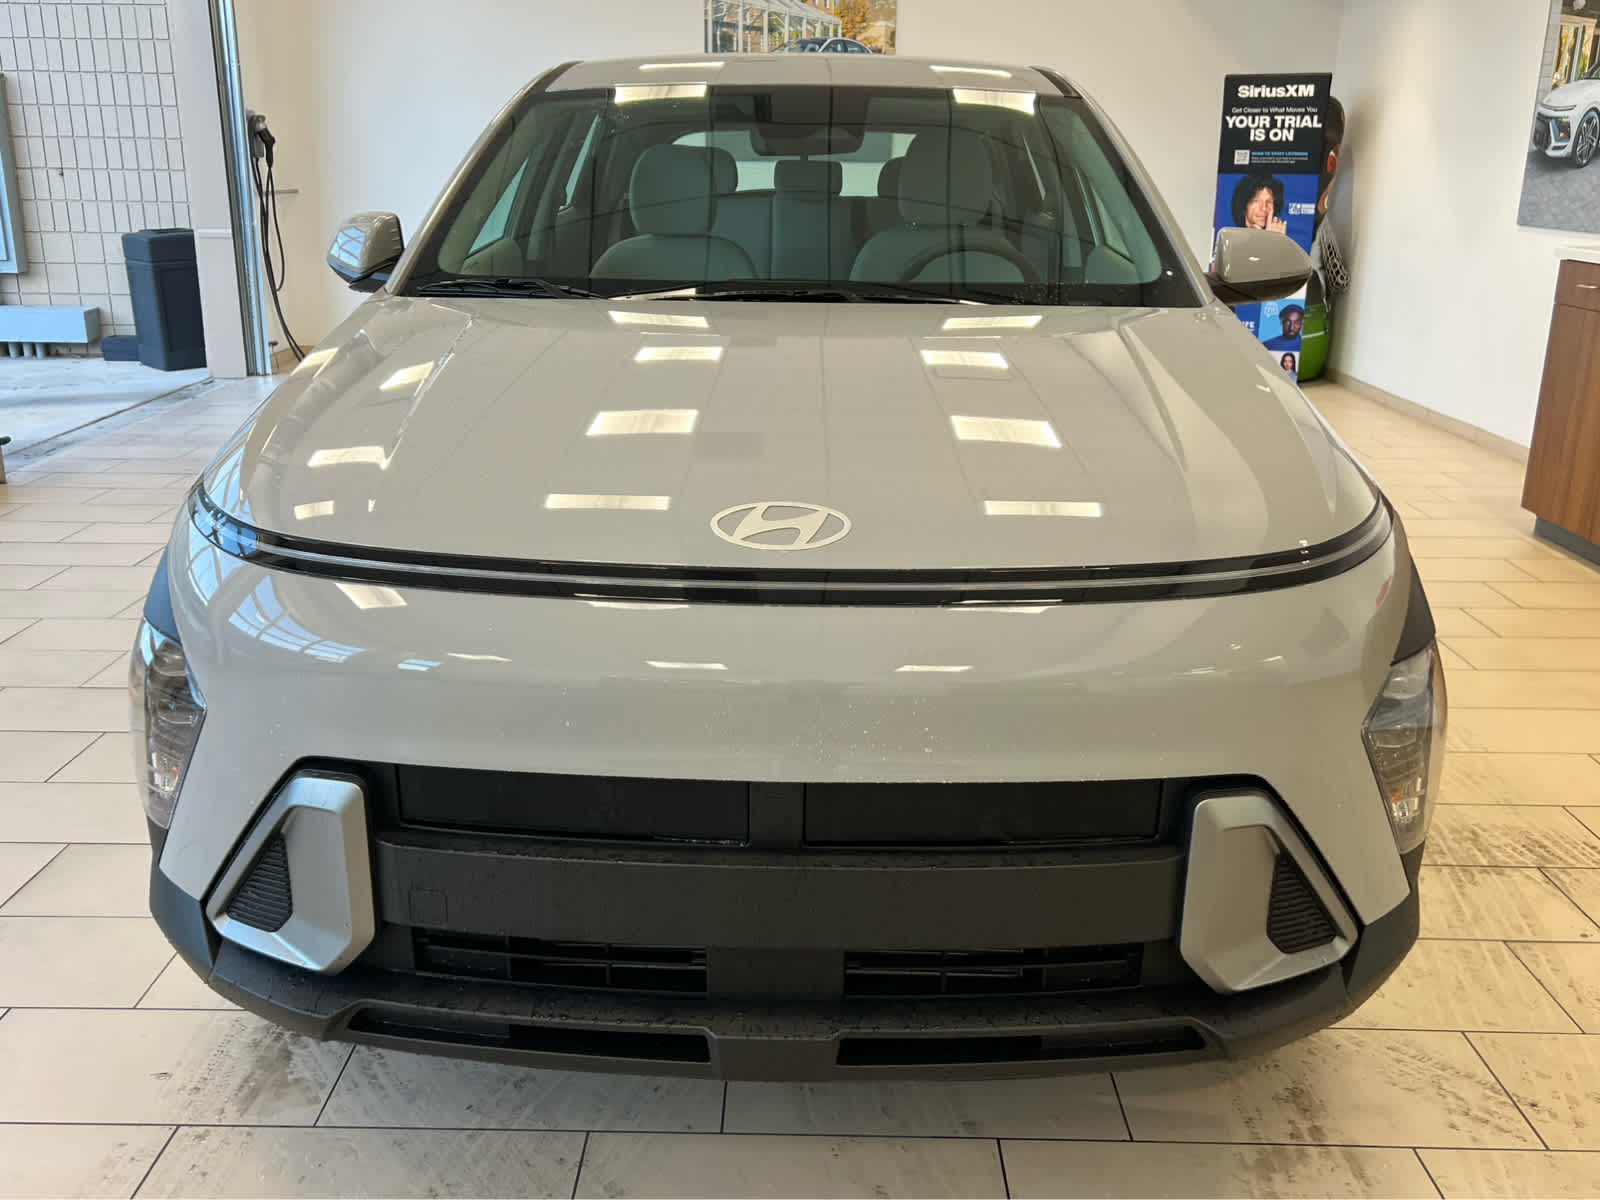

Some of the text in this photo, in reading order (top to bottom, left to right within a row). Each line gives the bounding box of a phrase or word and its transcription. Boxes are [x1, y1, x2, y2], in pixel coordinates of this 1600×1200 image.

[1238, 84, 1315, 98] SiriusXM
[1225, 115, 1322, 128] YOUR TRIAL
[1249, 128, 1294, 142] IS ON
